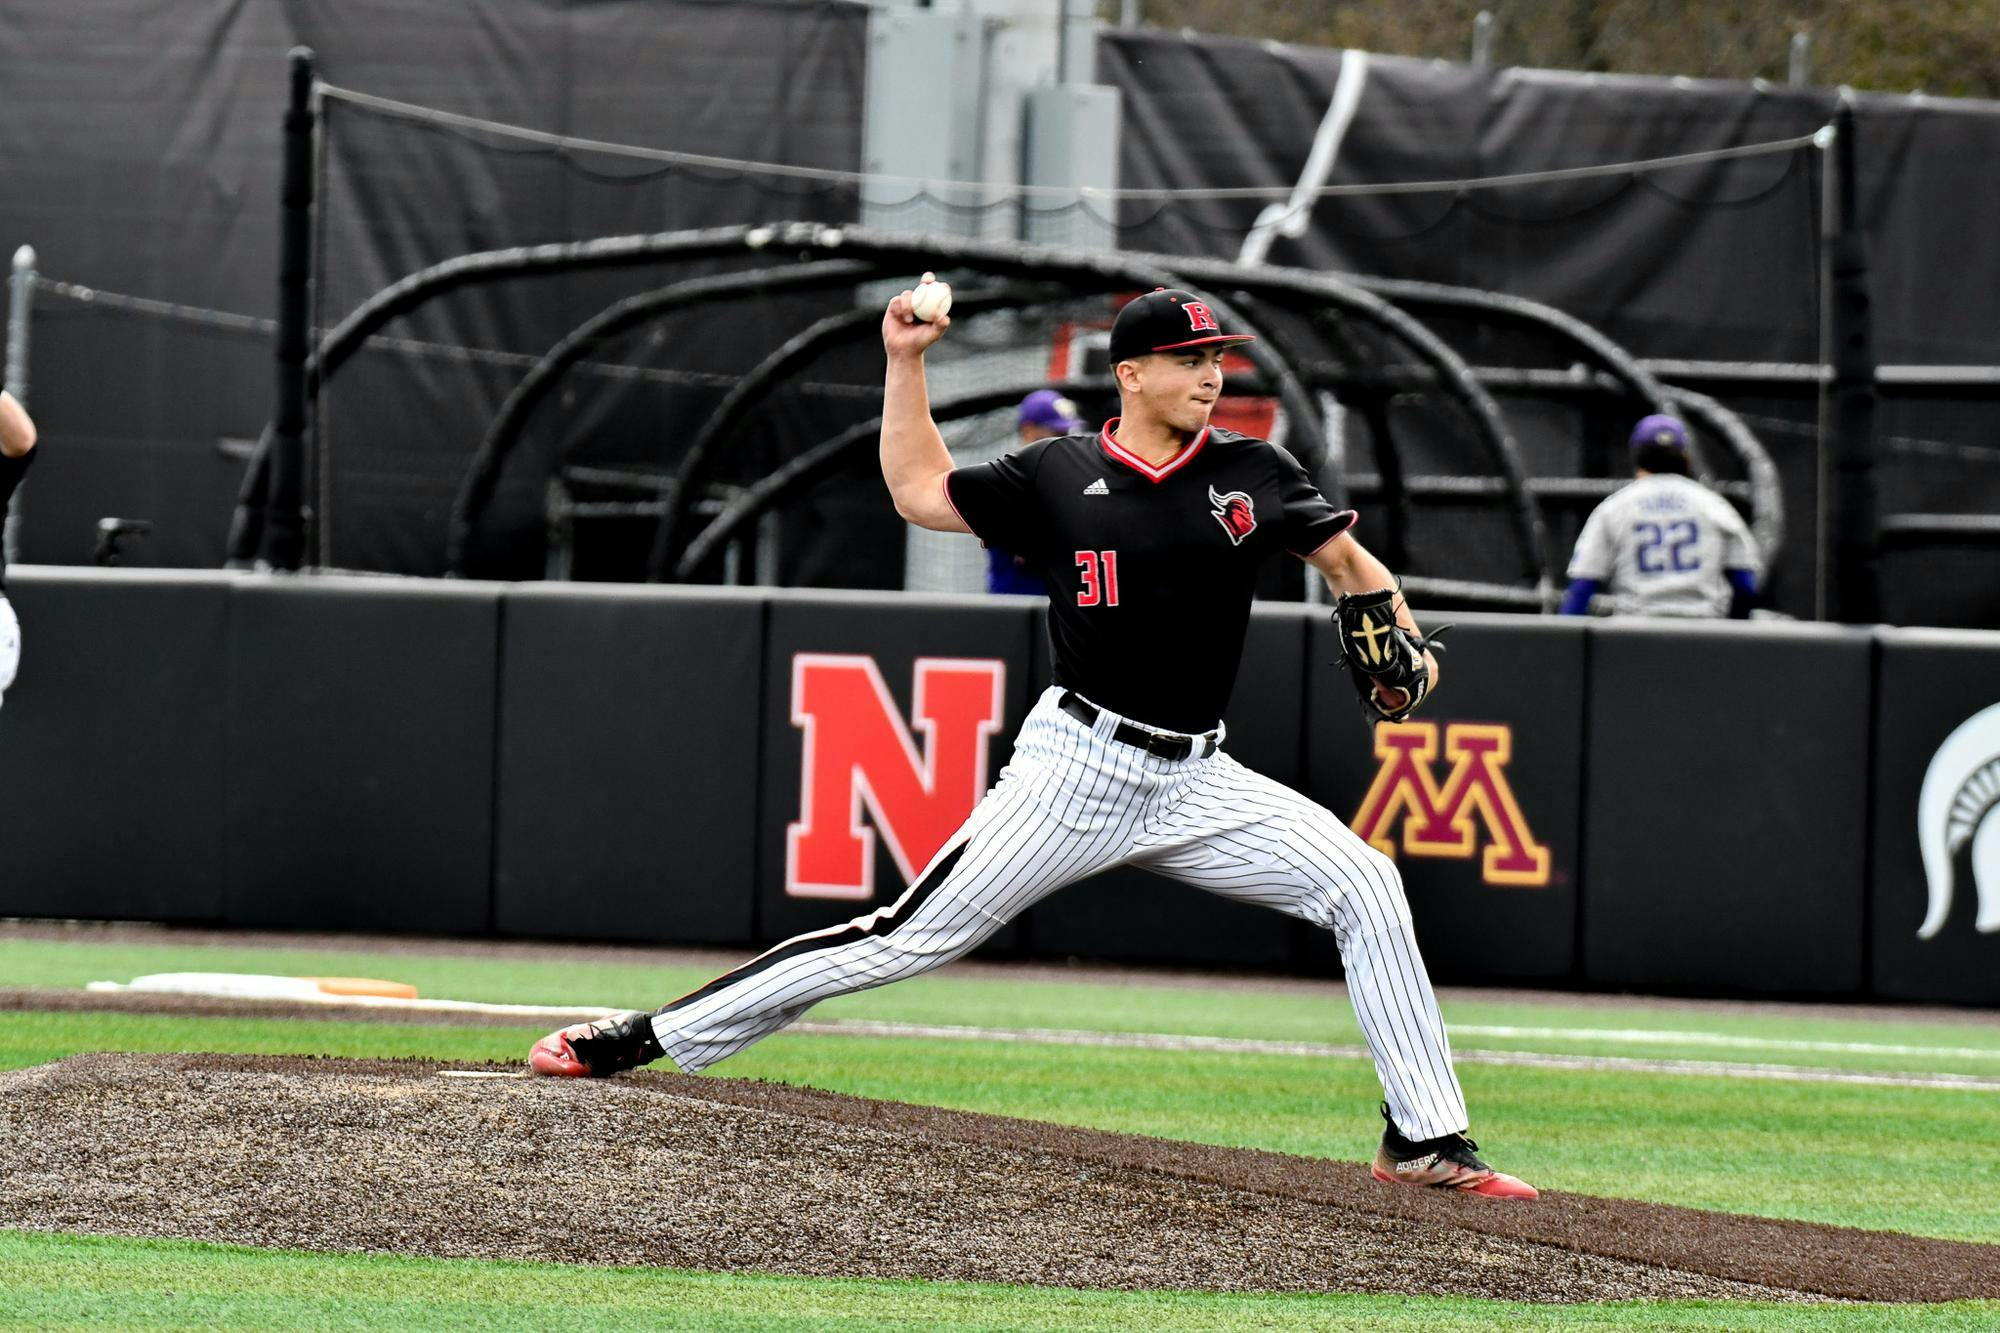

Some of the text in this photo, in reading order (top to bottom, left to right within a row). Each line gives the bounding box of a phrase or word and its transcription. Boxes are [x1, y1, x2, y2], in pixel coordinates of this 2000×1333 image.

[1181, 302, 1217, 331] R
[1634, 519, 1701, 574] 22
[1075, 550, 1119, 607] 31
[786, 653, 1006, 898] N
[1350, 721, 1551, 886] M
